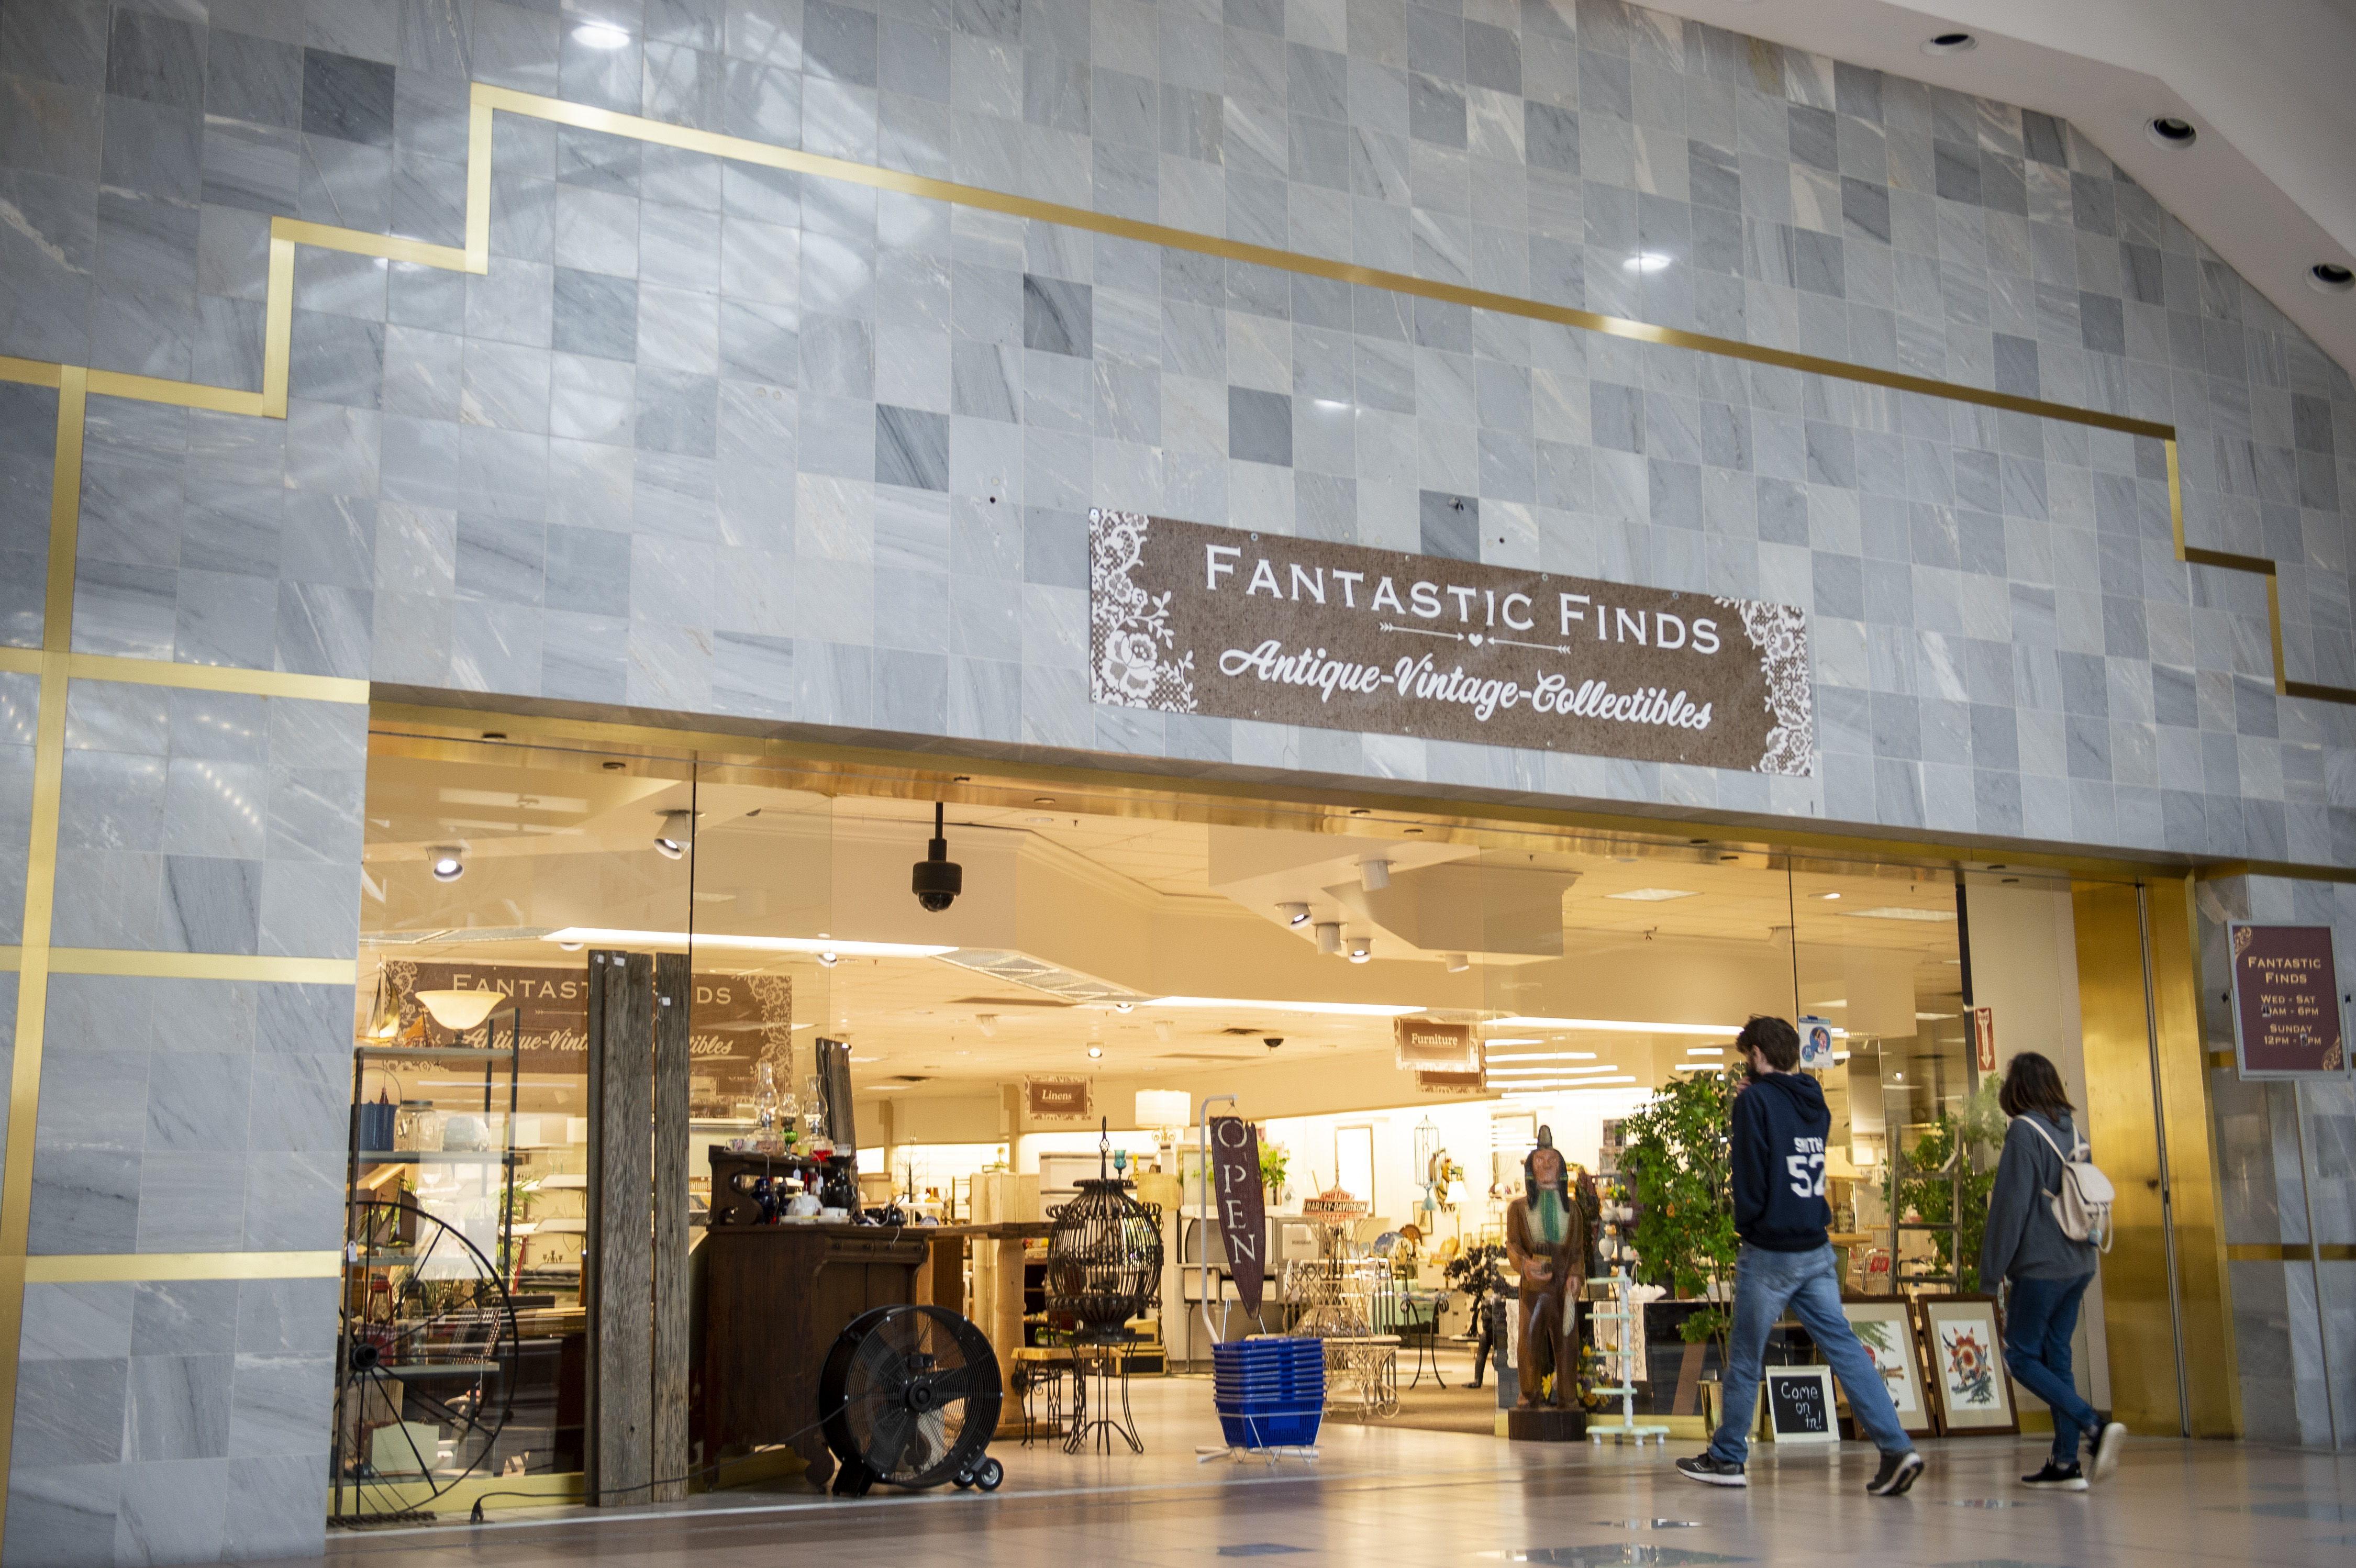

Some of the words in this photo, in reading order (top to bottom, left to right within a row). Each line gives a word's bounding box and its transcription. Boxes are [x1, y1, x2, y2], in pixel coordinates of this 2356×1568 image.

[1206, 544, 1534, 630] FANTASTIC
[1560, 593, 1720, 654] FINDS
[1219, 639, 1712, 730] Antique-Vintage-Collectibles
[2248, 957, 2321, 970] FANTASTIC
[2265, 972, 2307, 984] FINDS
[2261, 994, 2285, 1004] WED
[2296, 994, 2315, 1004] SAT
[2298, 1006, 2319, 1016] 6PM
[2270, 1024, 2313, 1033] SUNDAY
[1412, 1033, 1458, 1046] Furniture
[2264, 1035, 2289, 1045] 12PM
[1041, 1089, 1072, 1100] Linens
[1786, 1153, 1826, 1198] 52
[1218, 1119, 1255, 1264] OPEN
[1305, 1200, 1368, 1213] HARLEY-DAVIDSON
[1781, 1381, 1819, 1400] Come
[1796, 1402, 1811, 1415] on
[1805, 1409, 1821, 1430] in!
